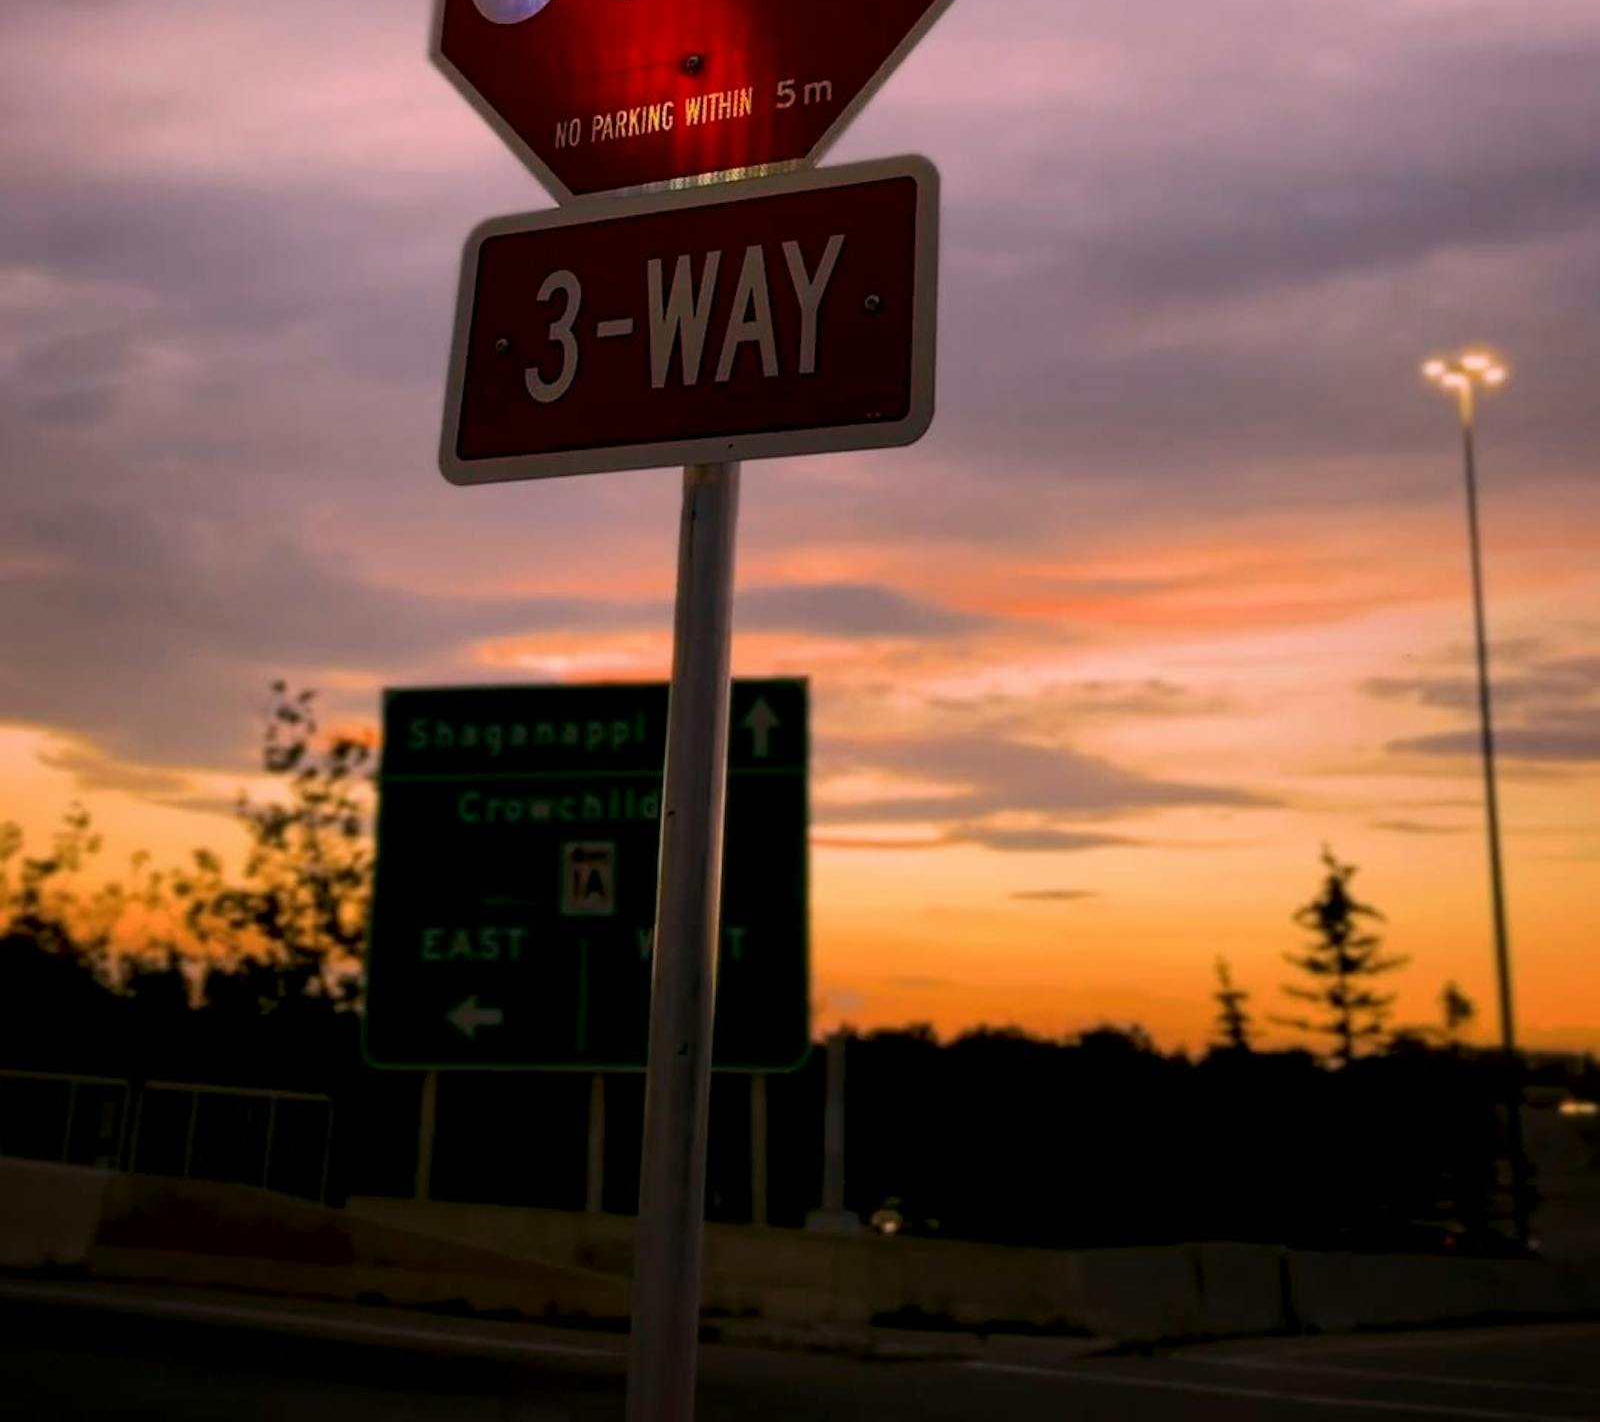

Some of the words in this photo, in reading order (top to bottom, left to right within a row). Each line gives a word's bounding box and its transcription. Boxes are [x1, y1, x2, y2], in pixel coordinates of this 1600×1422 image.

[554, 118, 581, 150] NO
[591, 101, 675, 143] PARKING
[684, 86, 754, 127] WITHIN
[523, 234, 846, 404] 3-WAY
[419, 925, 530, 962] EAST
